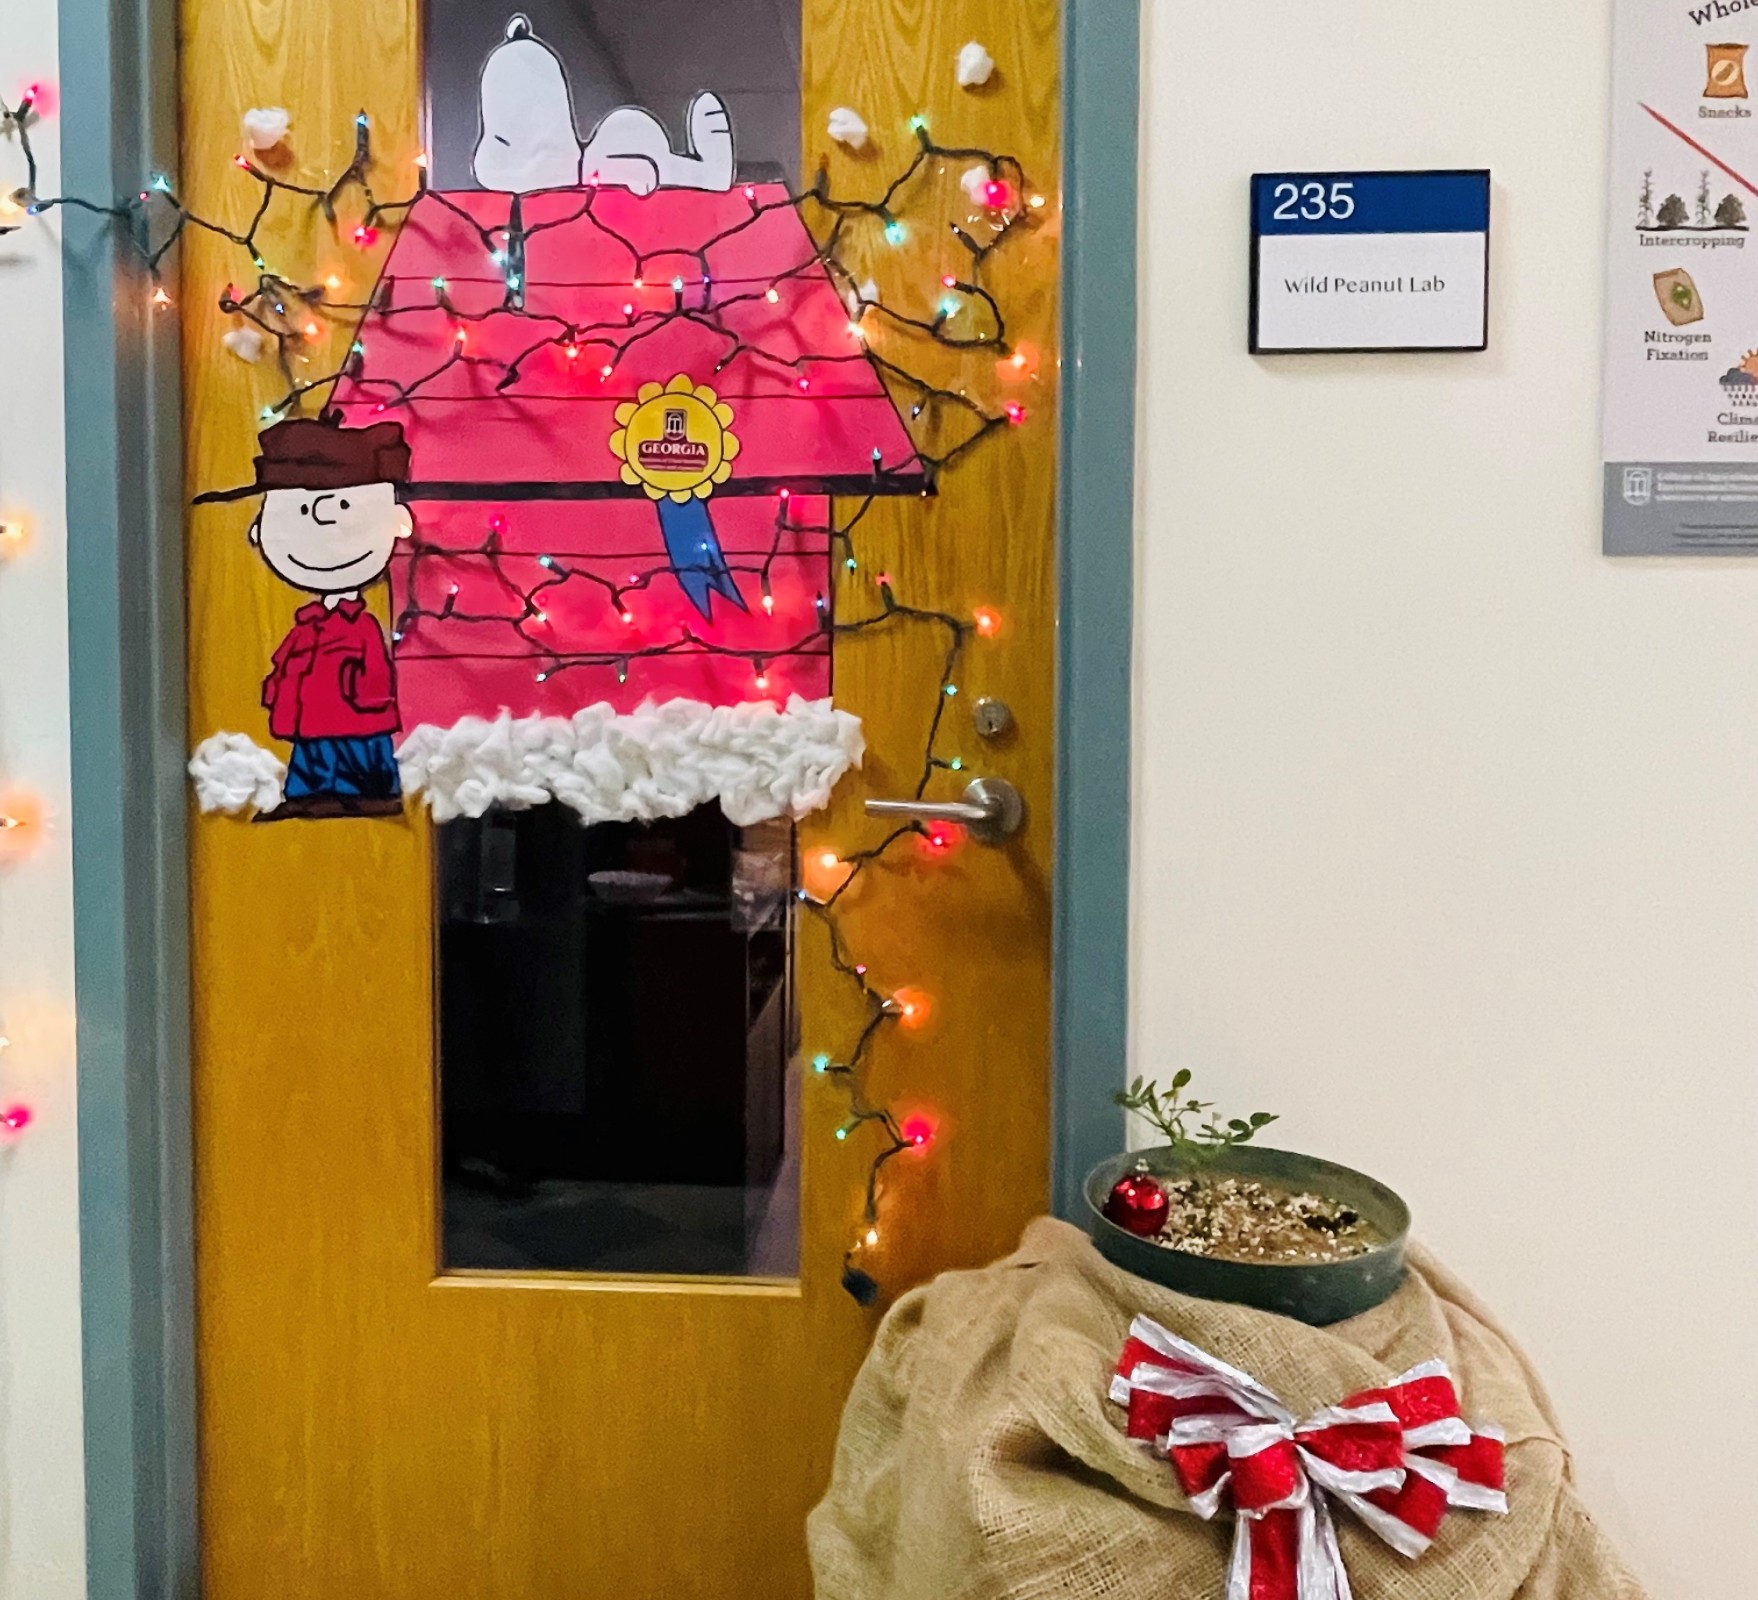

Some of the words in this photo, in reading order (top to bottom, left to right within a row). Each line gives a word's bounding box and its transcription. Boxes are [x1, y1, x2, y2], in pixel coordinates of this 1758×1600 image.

[1699, 105, 1751, 118] Snacks
[1273, 182, 1355, 220] 235
[1640, 234, 1745, 248] Intercropping
[1284, 276, 1328, 294] Wild
[1334, 277, 1403, 294] Peanut
[1410, 275, 1445, 293] Lab
[1644, 330, 1712, 345] Nitrogen
[1646, 348, 1709, 361] Fixation
[641, 442, 705, 456] GEORGIA
